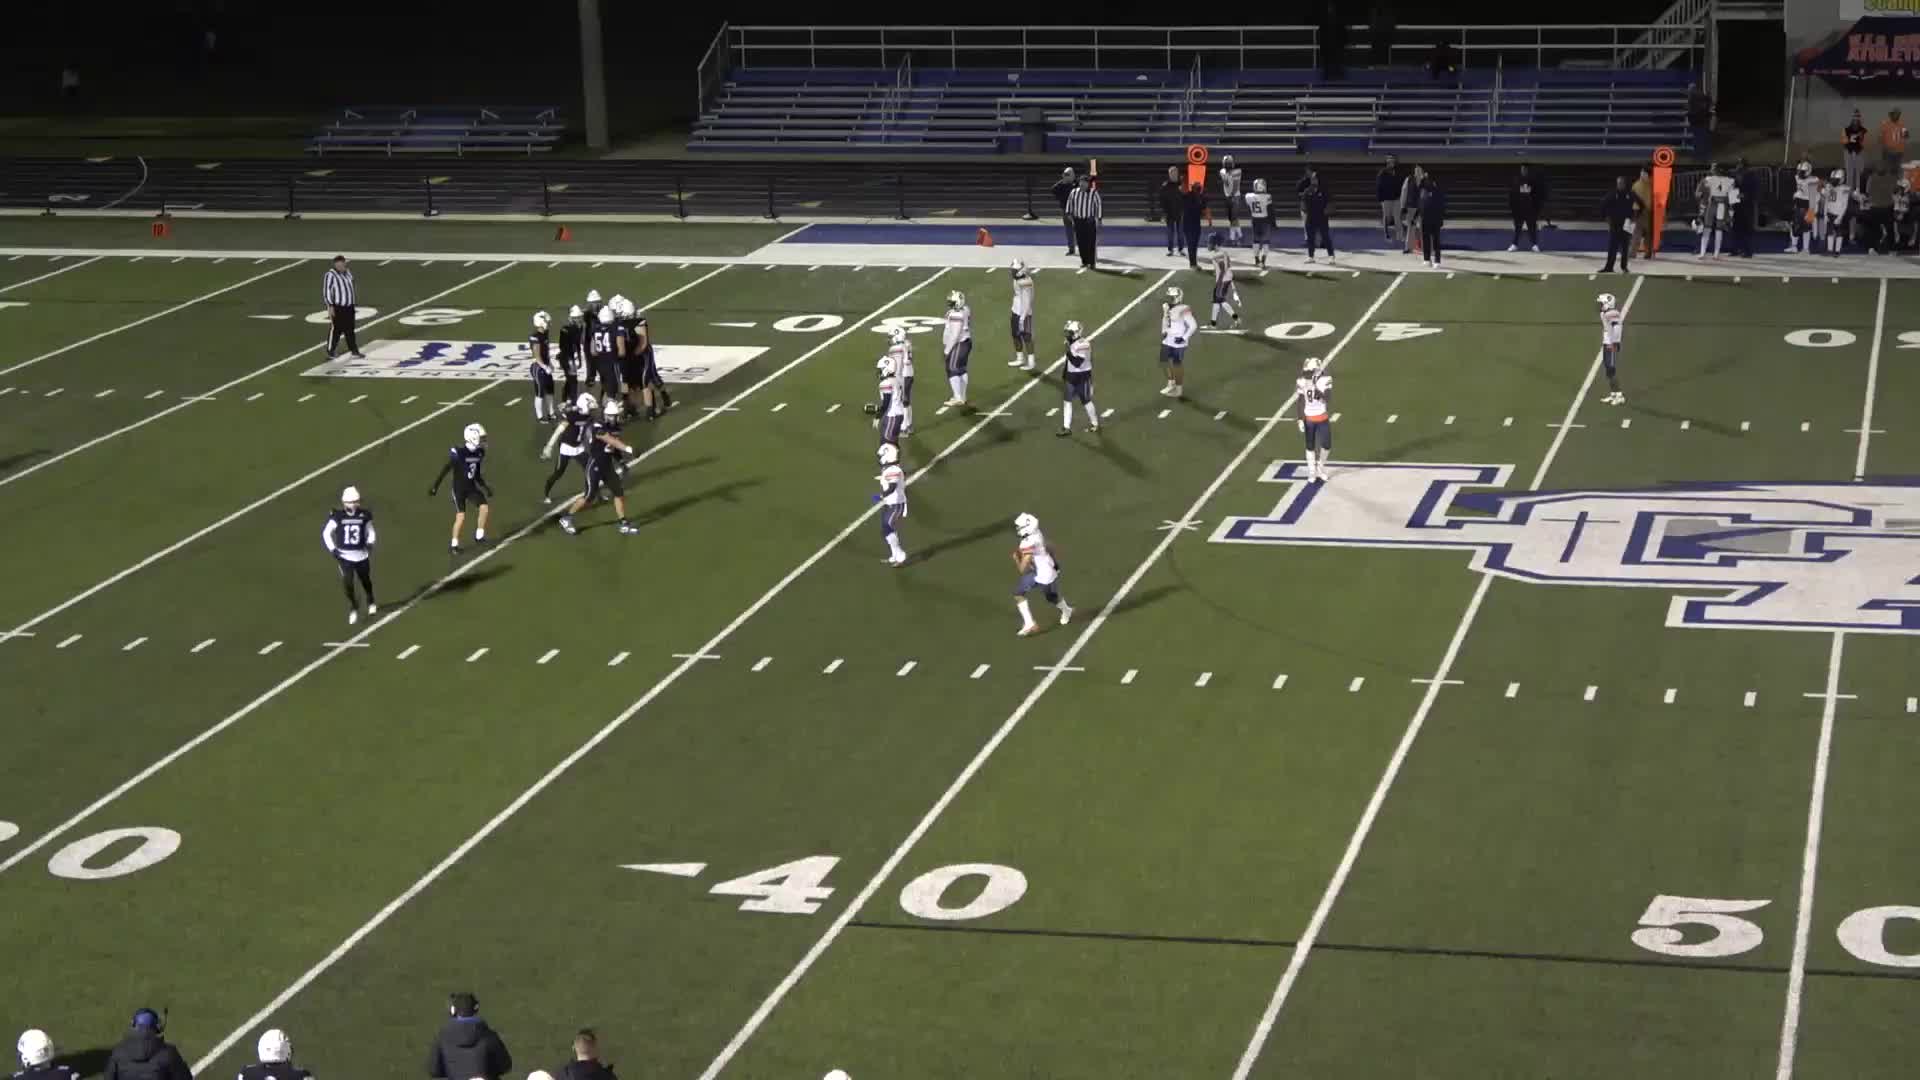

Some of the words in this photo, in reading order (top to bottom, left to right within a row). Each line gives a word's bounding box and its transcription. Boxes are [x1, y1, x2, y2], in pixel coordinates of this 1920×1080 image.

[1251, 201, 1263, 214] 15
[593, 331, 612, 353] 54
[467, 463, 477, 480] 3
[343, 524, 361, 545] 13
